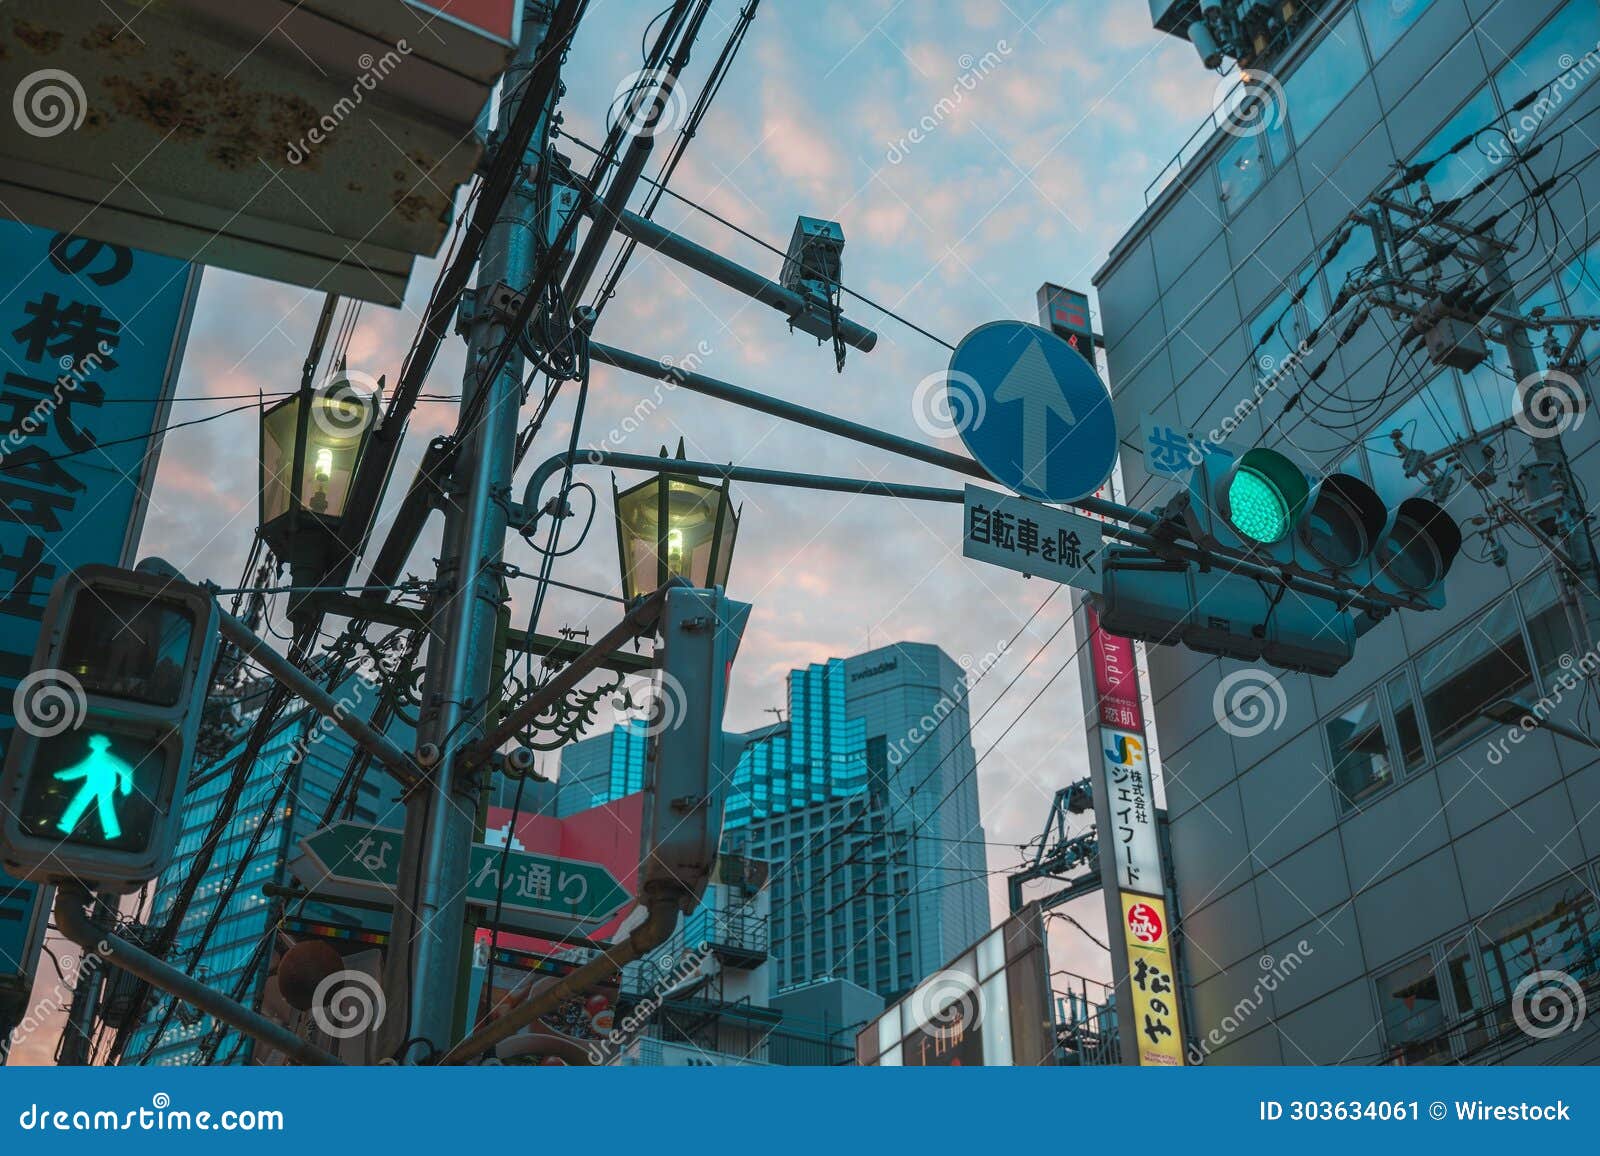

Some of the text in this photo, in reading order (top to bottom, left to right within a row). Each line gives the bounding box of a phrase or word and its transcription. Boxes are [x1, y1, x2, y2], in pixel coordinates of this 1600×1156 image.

[971, 504, 1096, 574] 自転車を除く
[1130, 770, 1148, 824] 株式会社
[1133, 958, 1172, 1044] 松のや
